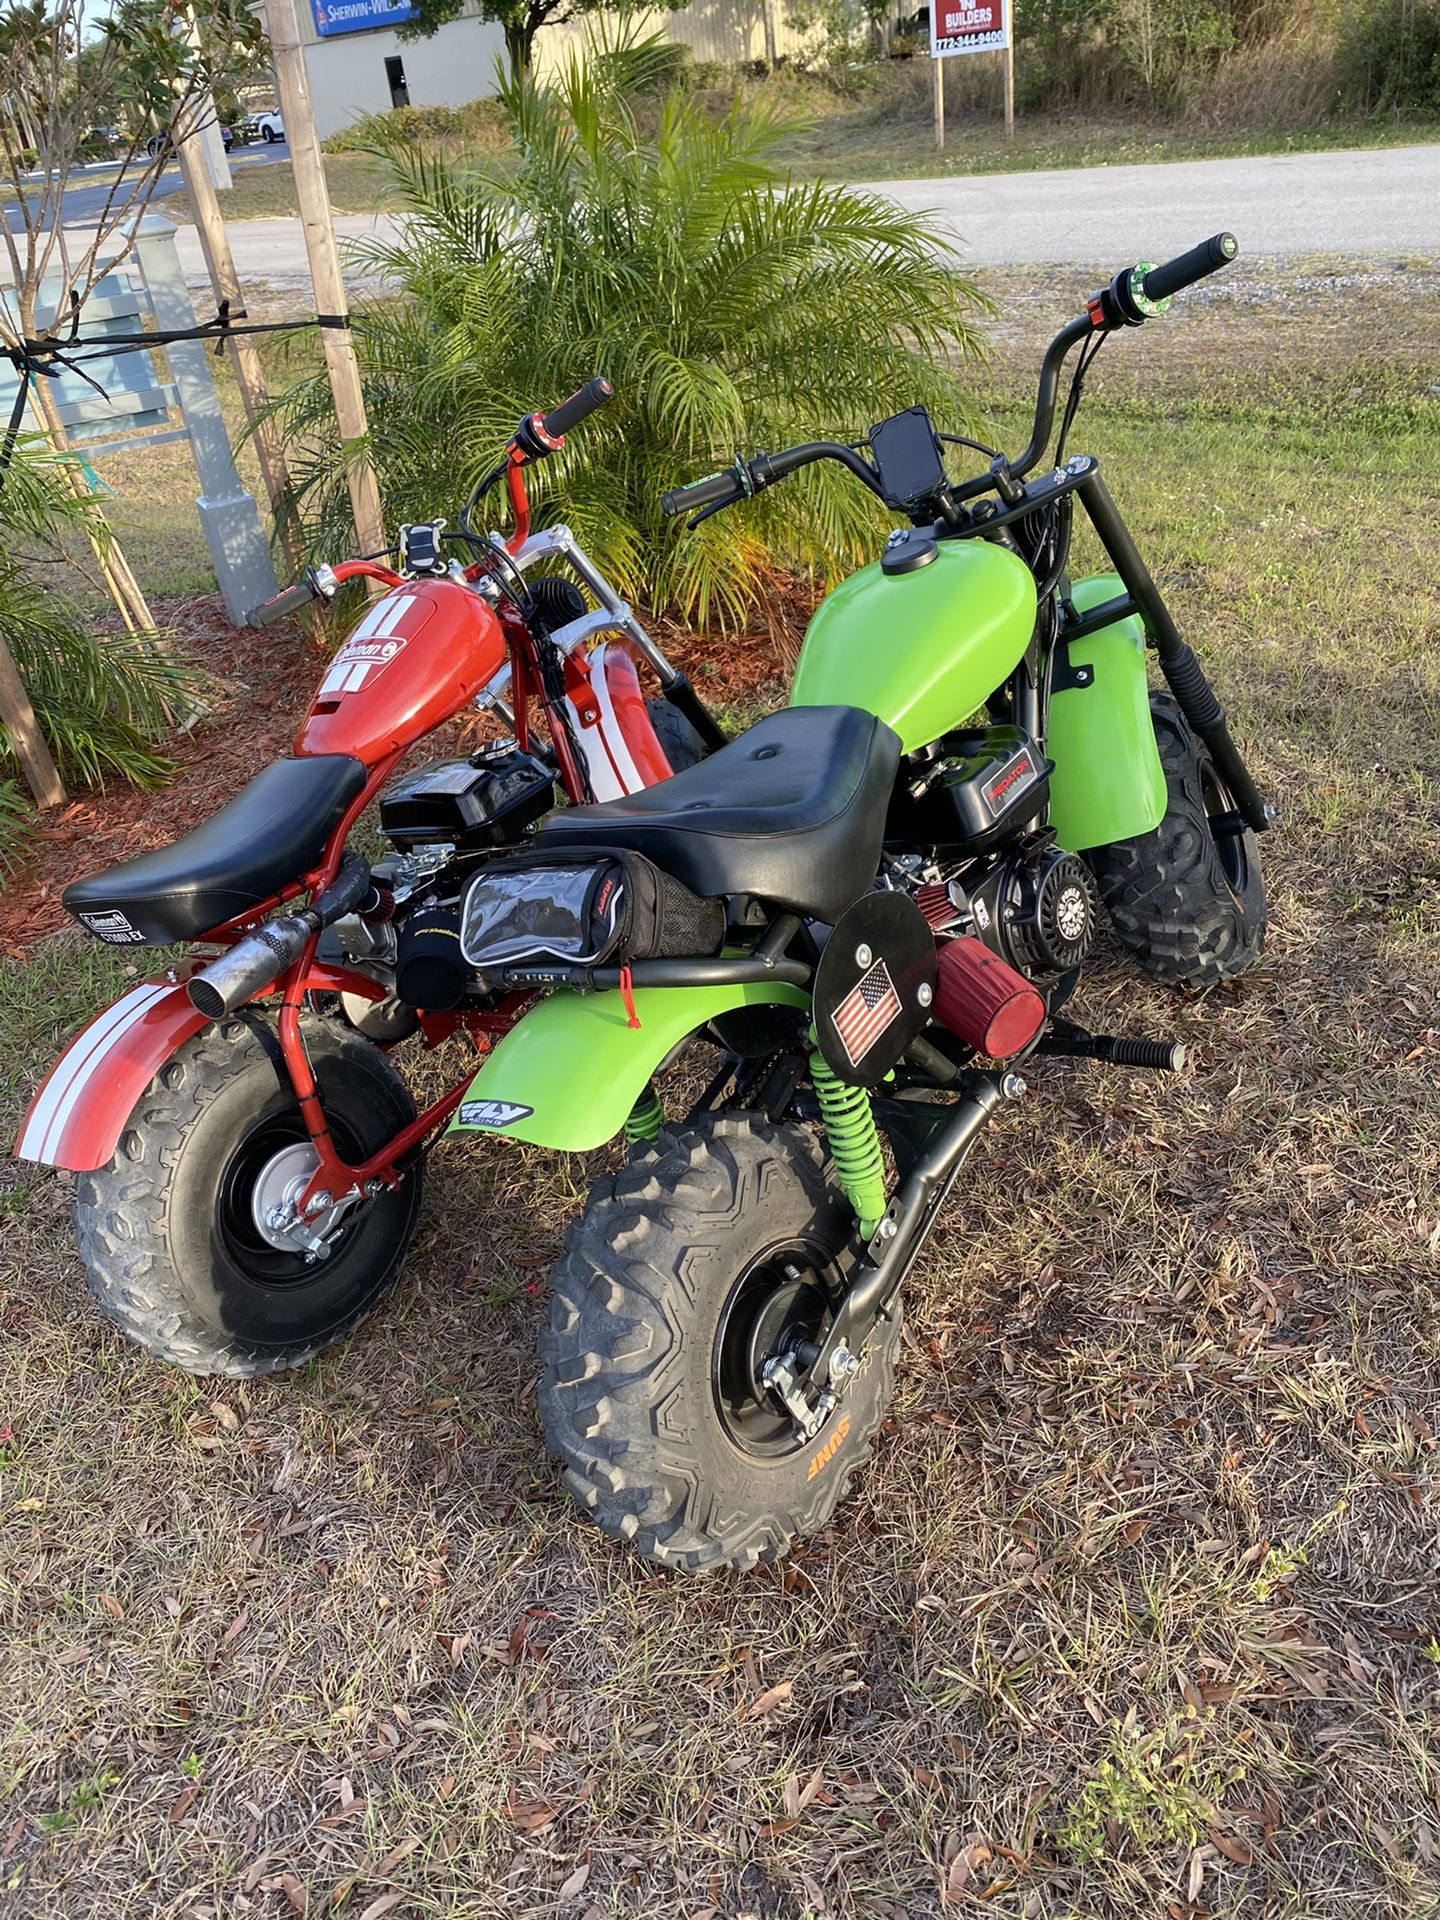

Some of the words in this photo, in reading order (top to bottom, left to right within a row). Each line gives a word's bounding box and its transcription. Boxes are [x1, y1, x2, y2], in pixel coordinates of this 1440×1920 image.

[945, 7, 993, 28] BUILDERS
[937, 30, 1003, 50] 772-344-9400
[988, 760, 1029, 801] PREDATOR
[461, 1102, 530, 1121] FLY
[461, 1117, 503, 1126] RACING
[806, 1413, 850, 1482] SUNF
